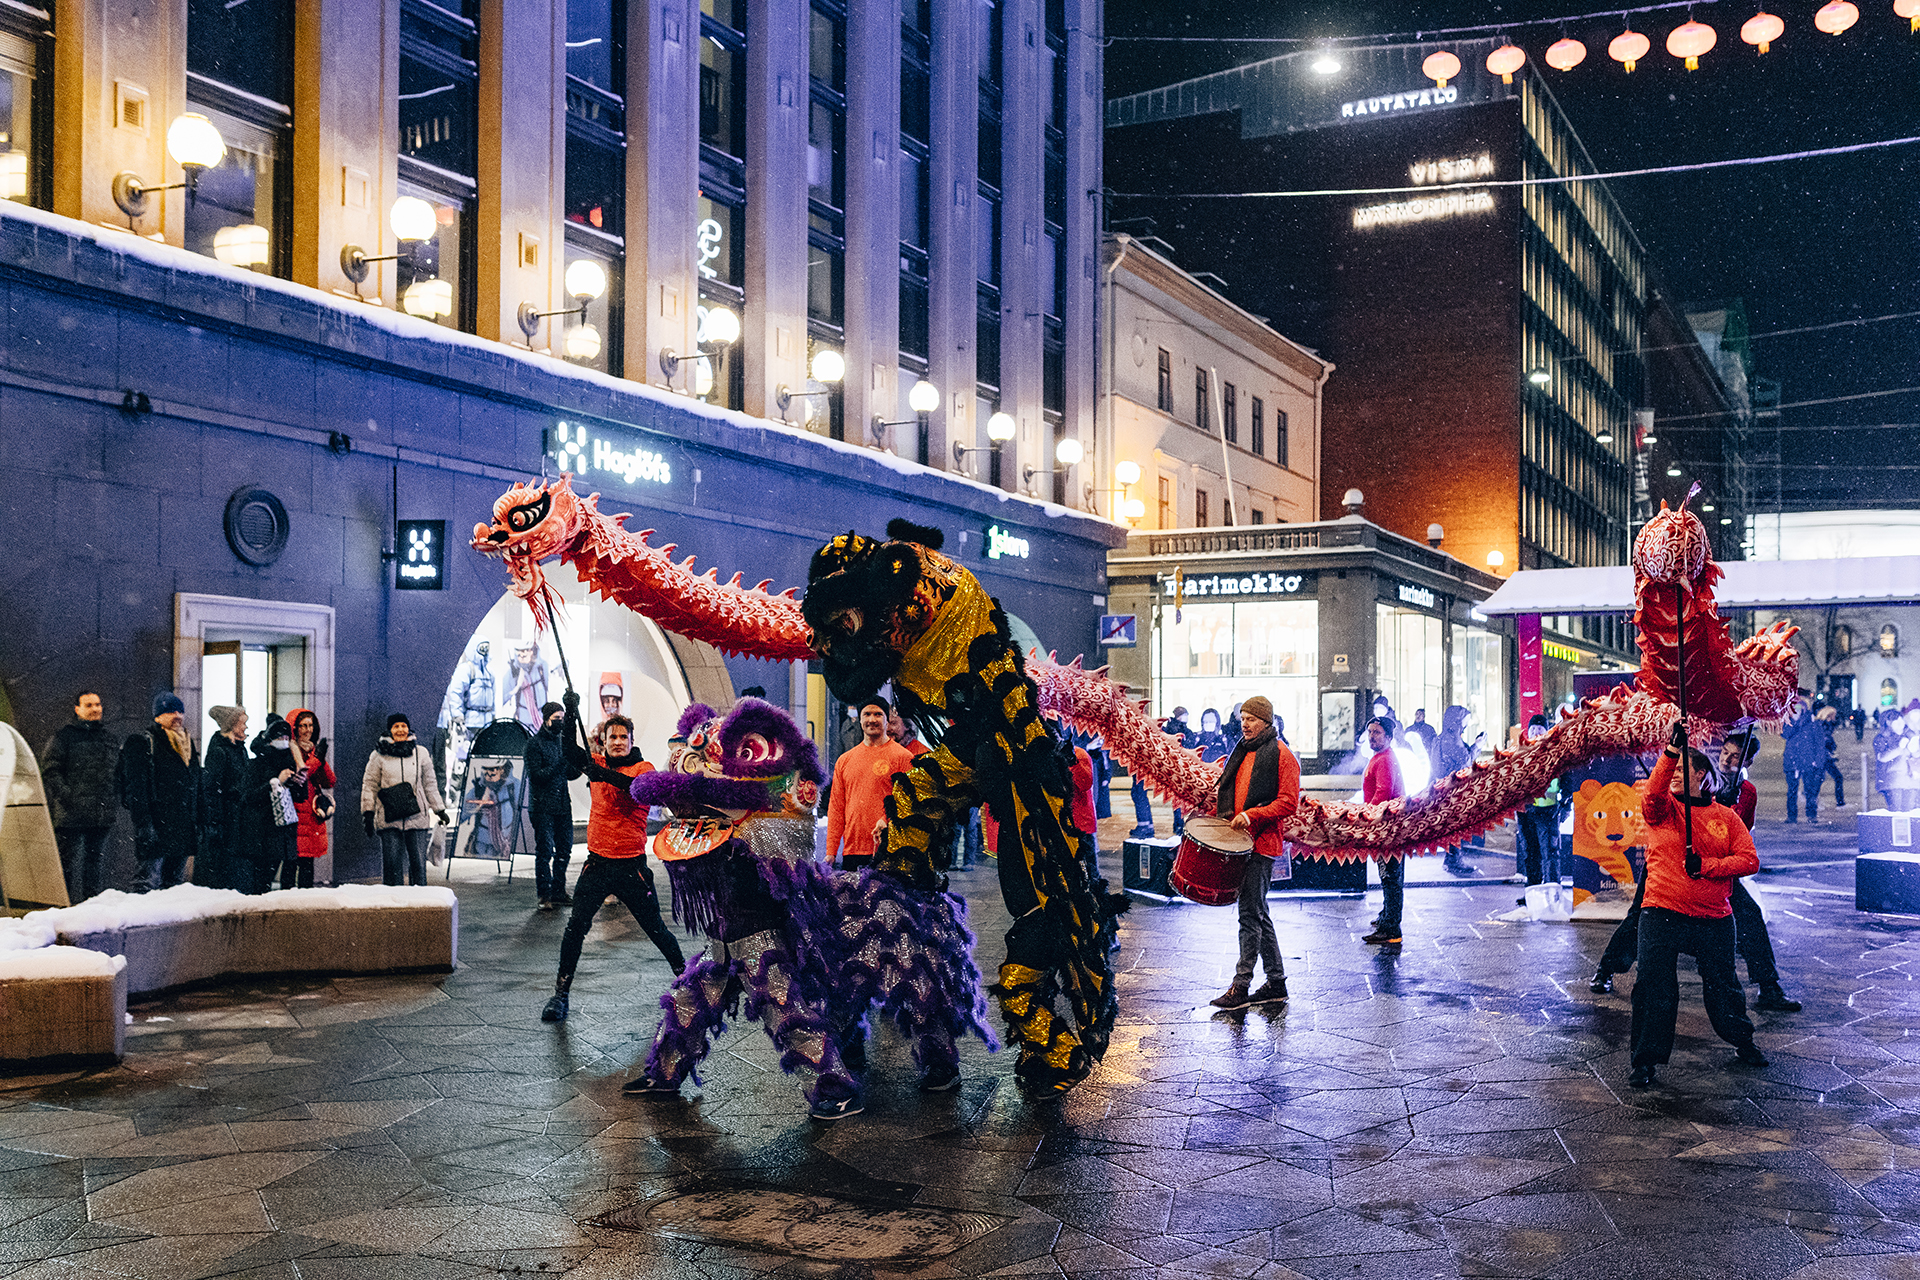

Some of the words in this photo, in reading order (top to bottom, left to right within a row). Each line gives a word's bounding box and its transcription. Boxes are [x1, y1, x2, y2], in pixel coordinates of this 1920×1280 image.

[1341, 87, 1458, 118] RAUTATALO
[1410, 155, 1493, 184] VISMA
[1354, 193, 1493, 226] MARMORIPIHA
